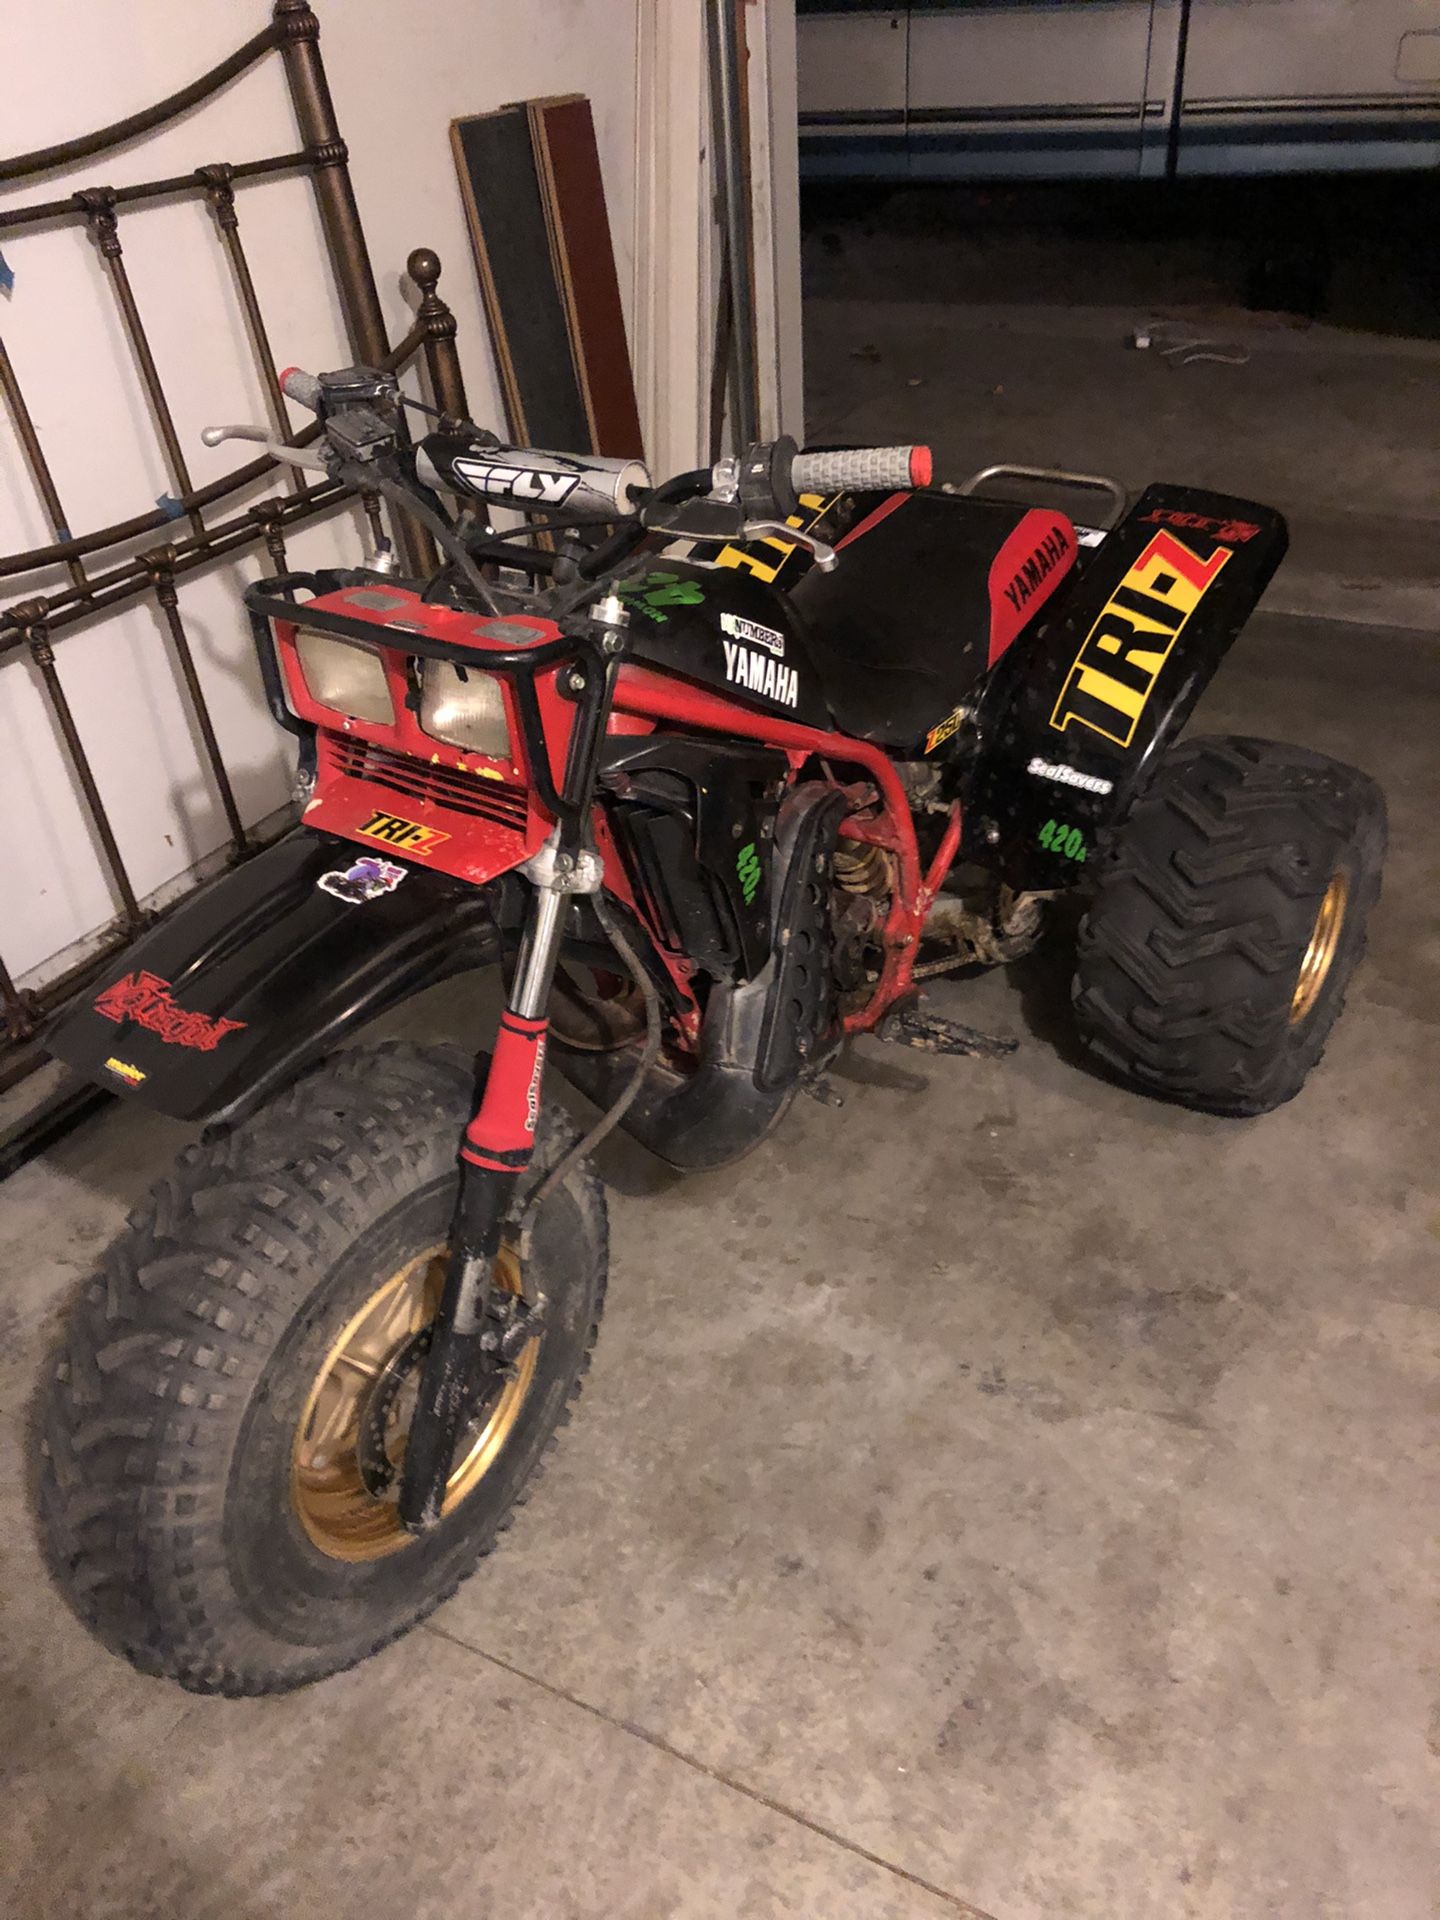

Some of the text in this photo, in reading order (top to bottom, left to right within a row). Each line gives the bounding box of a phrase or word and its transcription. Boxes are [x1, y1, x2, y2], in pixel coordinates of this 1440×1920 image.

[455, 461, 579, 503] FLY
[1003, 527, 1069, 612] YAMAHA
[1050, 528, 1234, 748] TRI-Z
[723, 641, 798, 708] YAMAHA
[1027, 757, 1113, 795] SealSavers
[356, 809, 452, 856] TRI-Z
